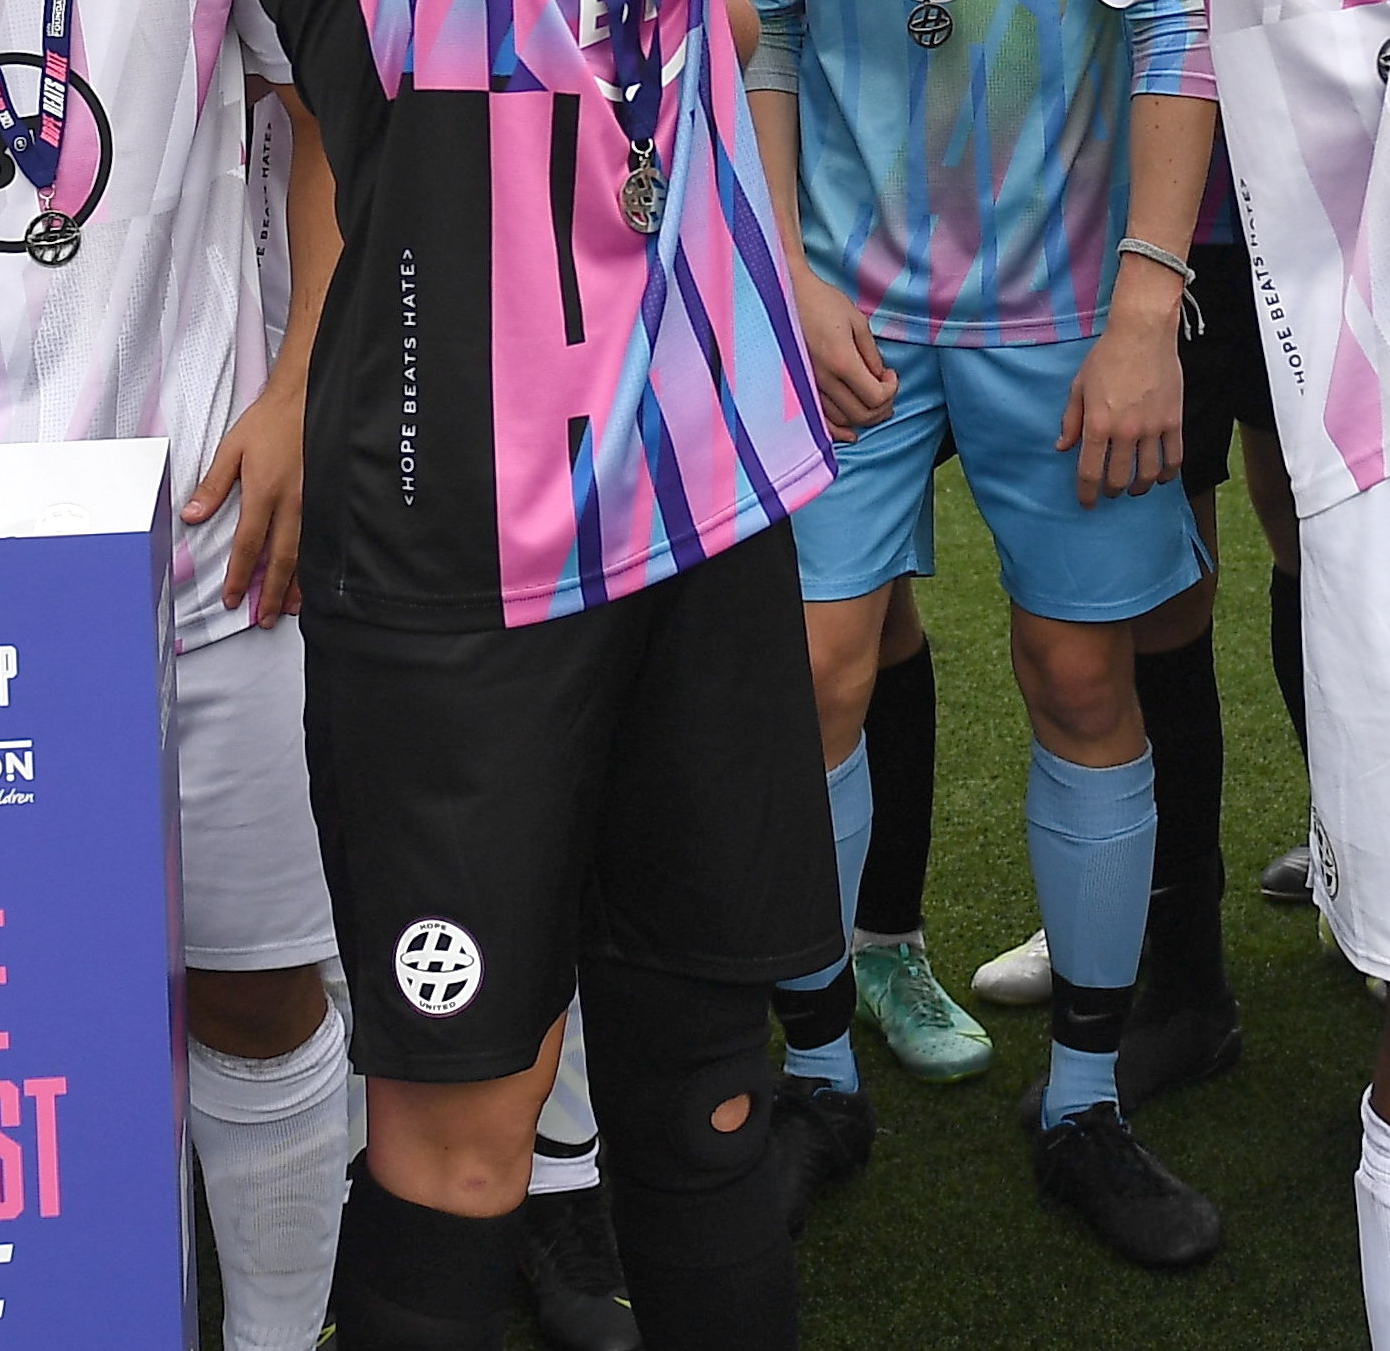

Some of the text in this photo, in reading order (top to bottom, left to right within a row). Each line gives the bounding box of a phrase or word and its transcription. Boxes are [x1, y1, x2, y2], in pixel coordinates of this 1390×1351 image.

[1253, 256, 1285, 321] BEATS
[404, 337, 417, 414] BEATS
[419, 922, 447, 931] HOPE
[419, 1000, 457, 1011] UNITED
